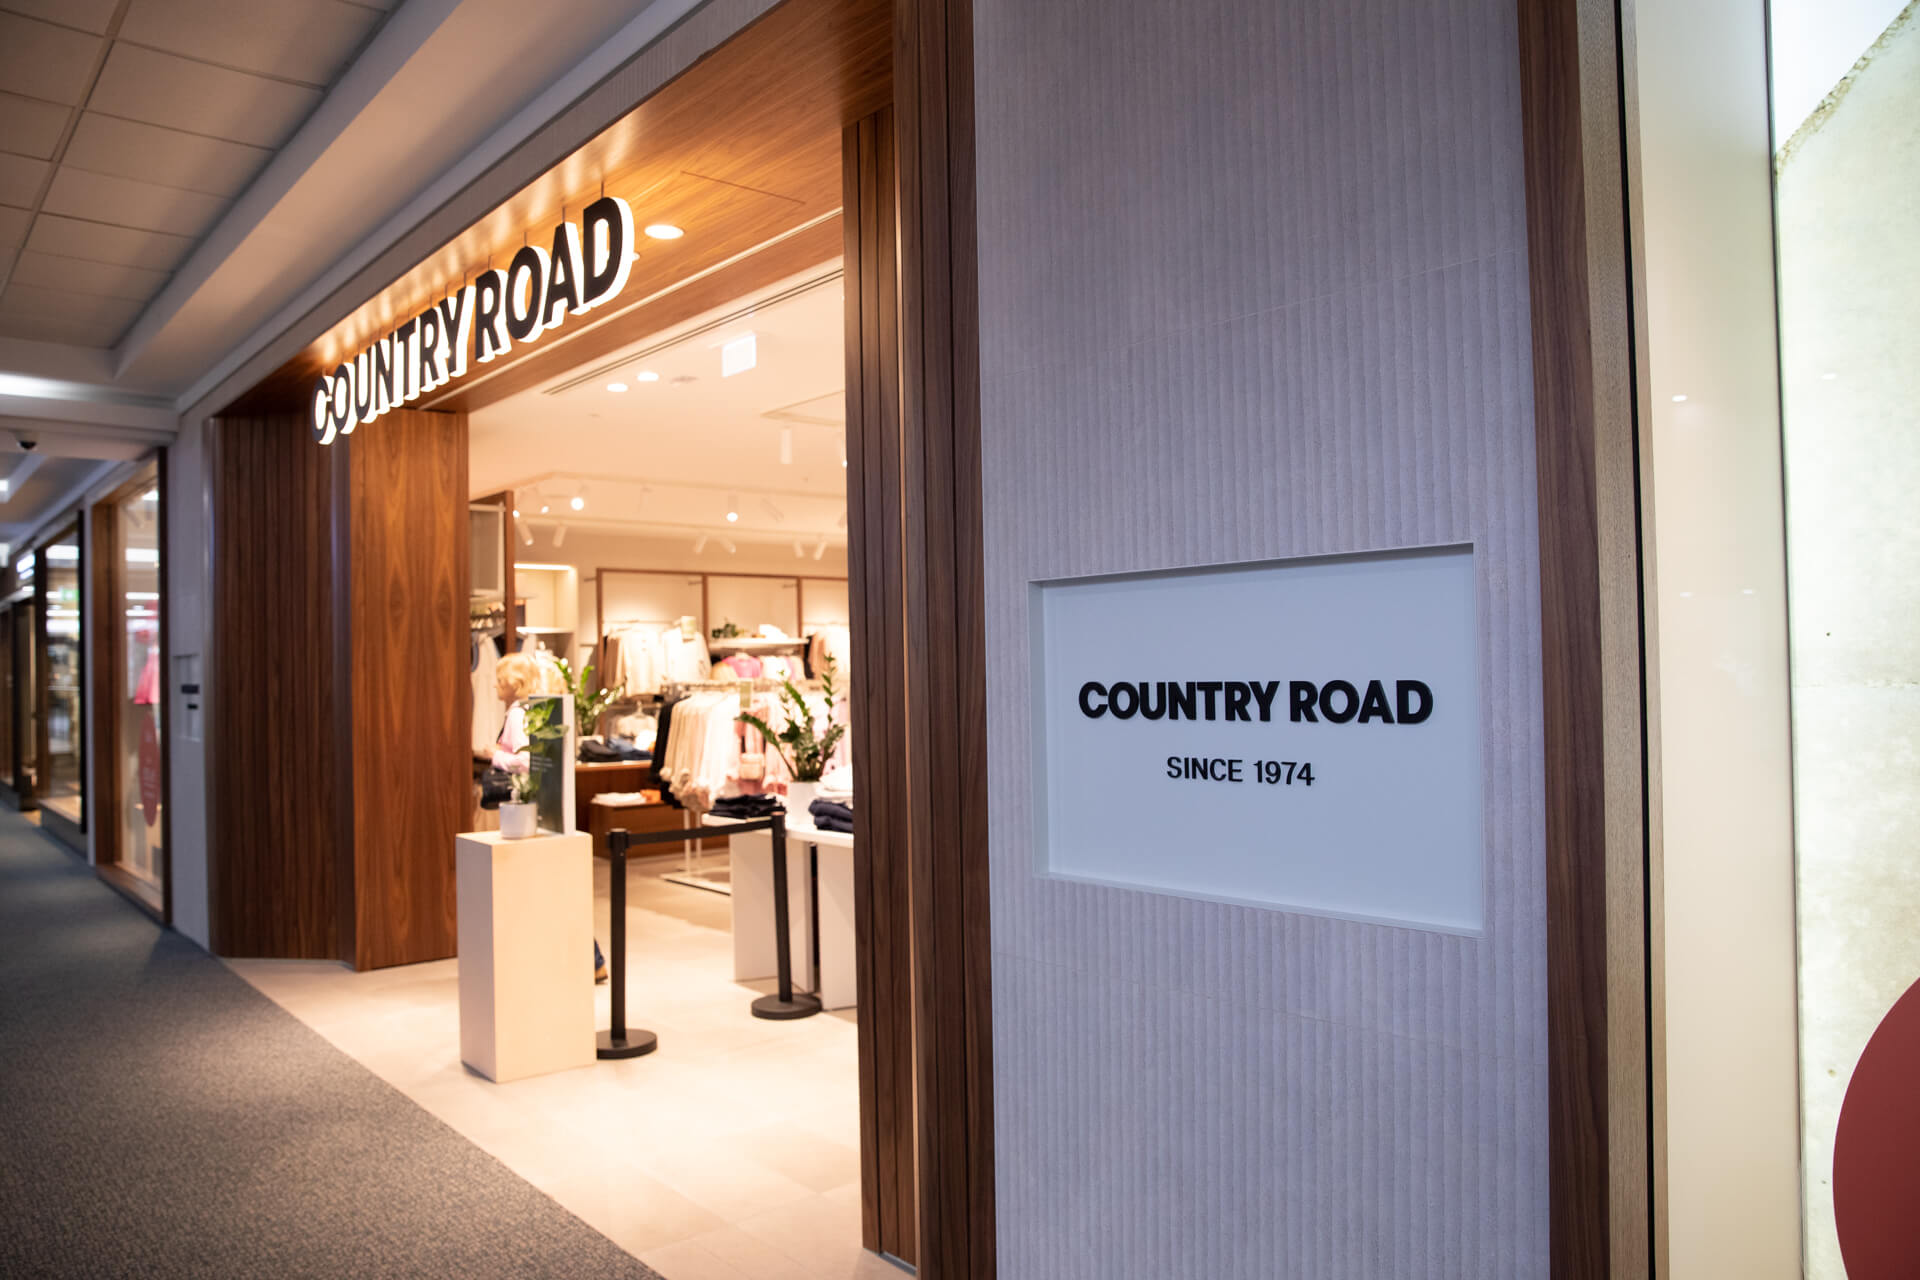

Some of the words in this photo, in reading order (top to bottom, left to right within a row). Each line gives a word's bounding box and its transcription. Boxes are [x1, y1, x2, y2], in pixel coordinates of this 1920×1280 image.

[311, 286, 471, 444] COUNTRY
[475, 196, 633, 362] ROAD
[1078, 680, 1280, 723] COUNTRY
[1289, 679, 1435, 725] ROAD
[1166, 756, 1243, 783] SINCE
[1253, 760, 1316, 787] 1974
